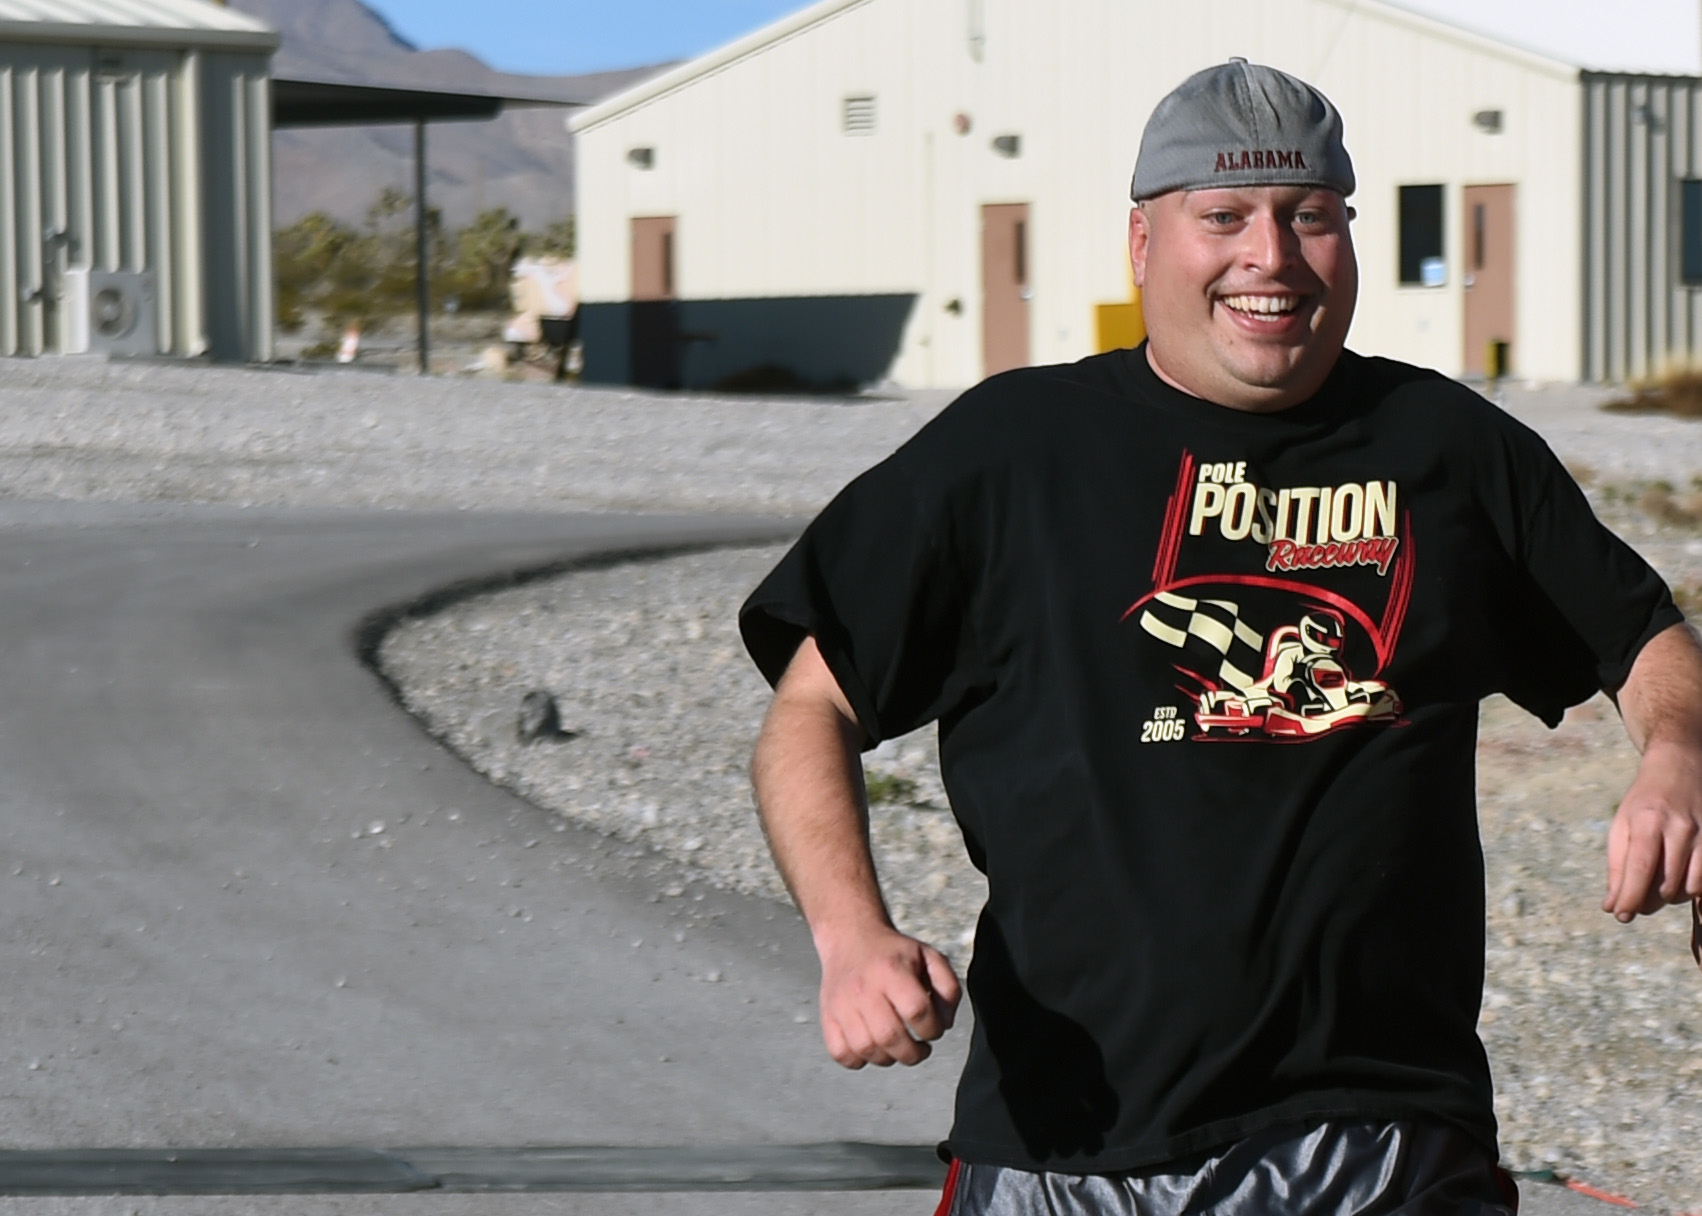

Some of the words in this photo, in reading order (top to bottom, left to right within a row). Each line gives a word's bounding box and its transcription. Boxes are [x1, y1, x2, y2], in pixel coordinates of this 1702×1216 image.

[1213, 150, 1307, 172] ALABAMA
[1199, 461, 1247, 483] POLE
[1189, 480, 1397, 544] POSITION
[1266, 536, 1399, 576] Raceway
[1141, 719, 1185, 742] 2005
